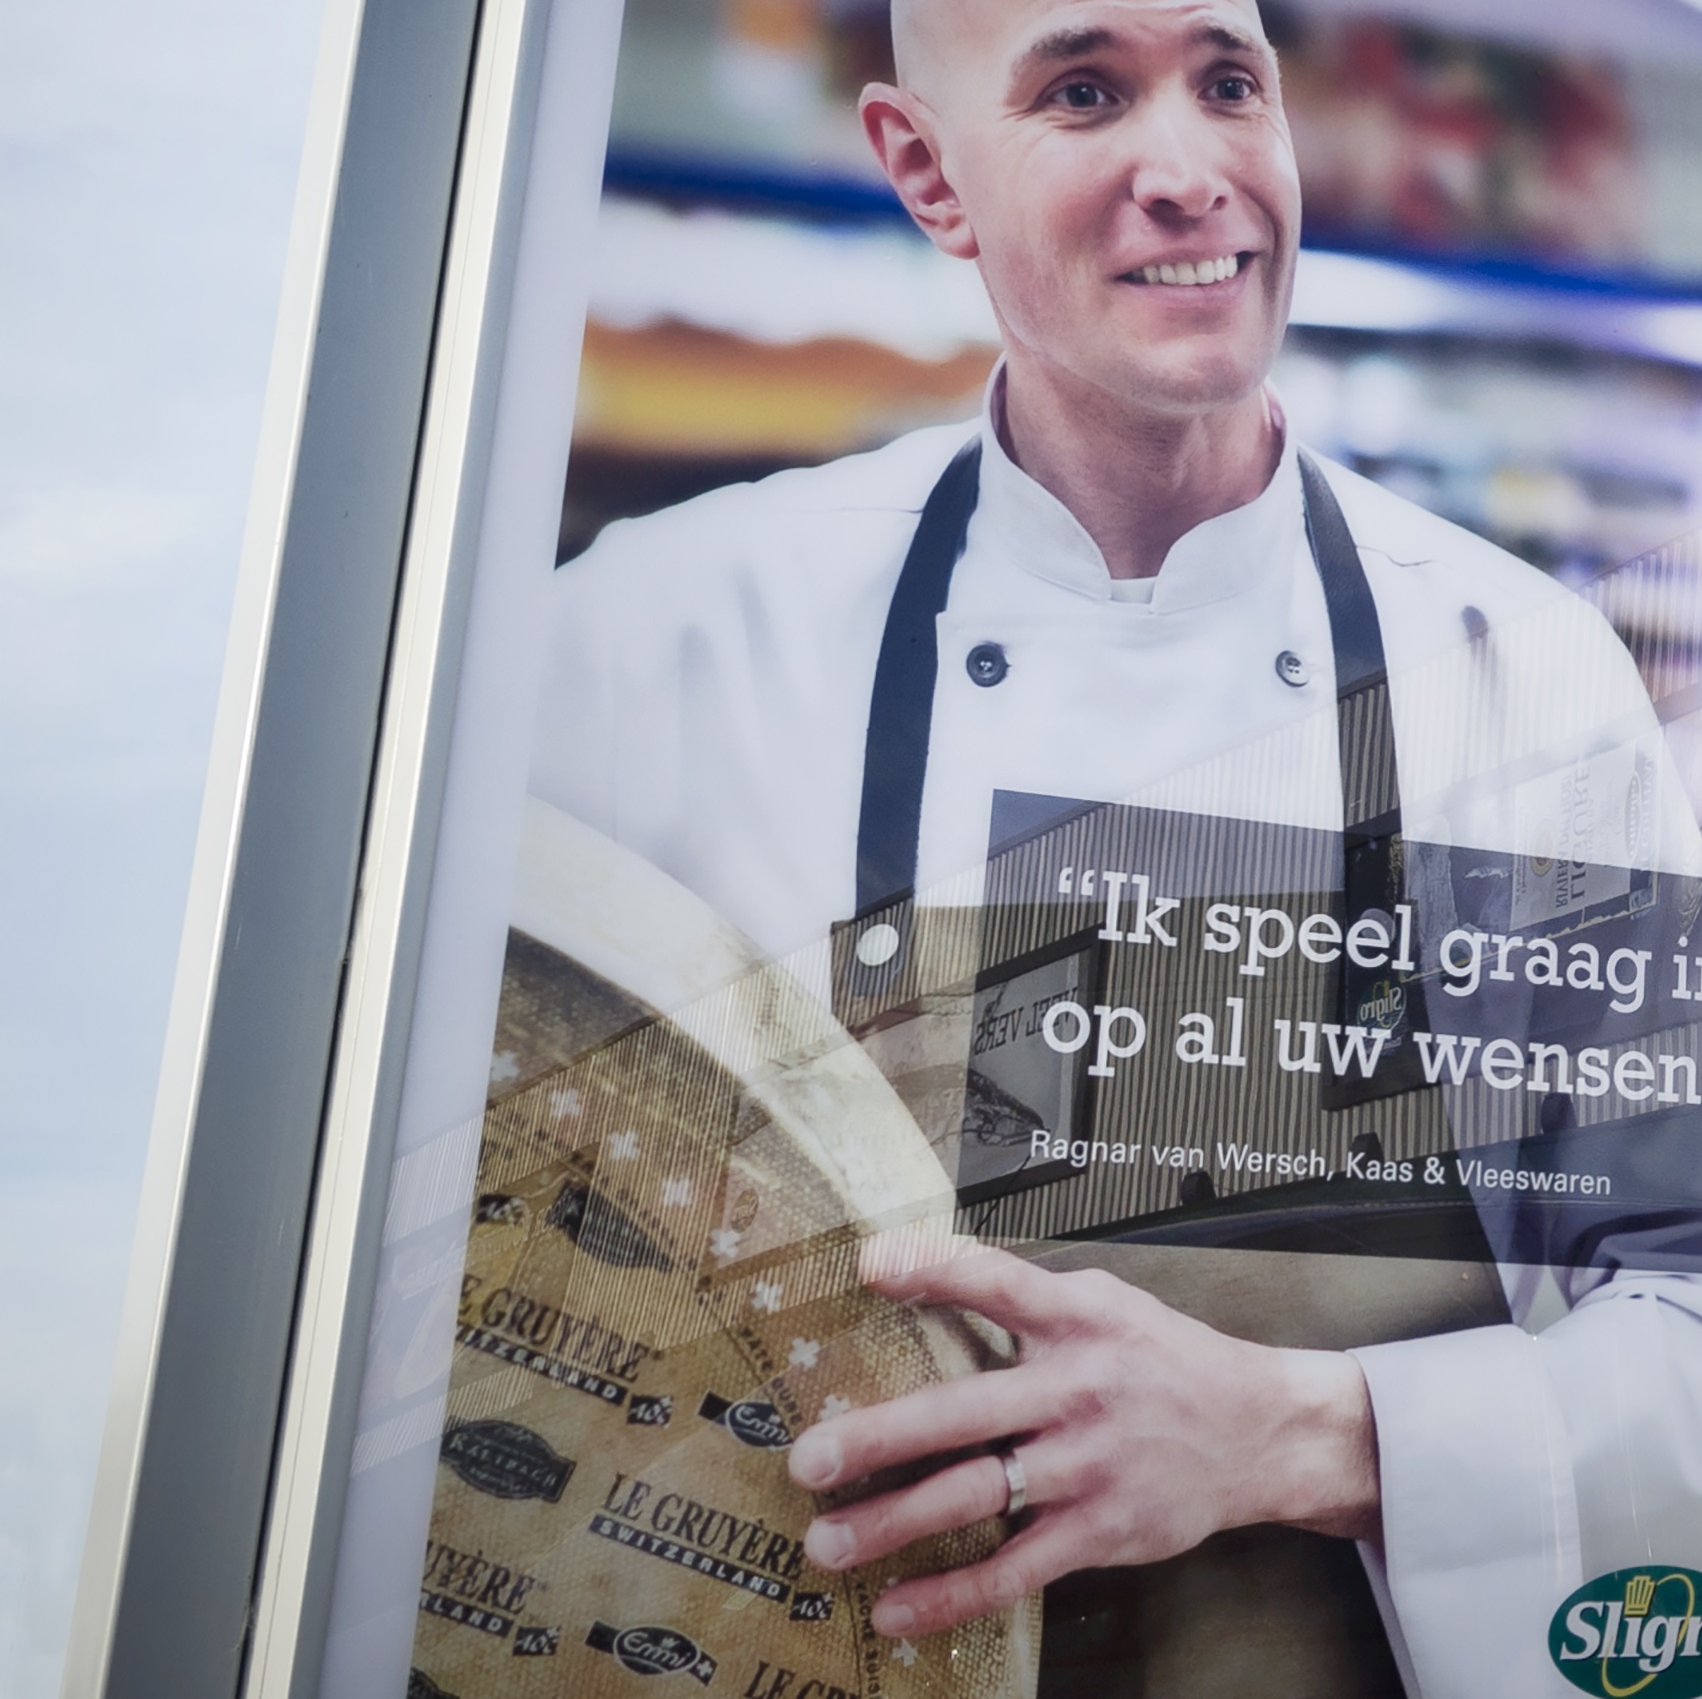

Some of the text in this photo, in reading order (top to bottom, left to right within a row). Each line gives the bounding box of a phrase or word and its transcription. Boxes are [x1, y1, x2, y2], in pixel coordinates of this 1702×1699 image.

[1058, 867, 1178, 947] “Ik
[1203, 904, 1414, 976] speel
[1440, 929, 1652, 1013] graag
[1041, 998, 1146, 1078] op
[1177, 997, 1245, 1066] al
[1276, 1020, 1391, 1079] uw
[1029, 1129, 1612, 1195] Ragnar van Wersch, Kaas & Vleeswaren
[600, 1520, 780, 1598] SWITZERLAND
[602, 1472, 652, 1521] LE
[650, 1493, 804, 1580] GRUYÈRE
[422, 1540, 536, 1615] UYÈRE
[623, 1631, 690, 1668] Emmi
